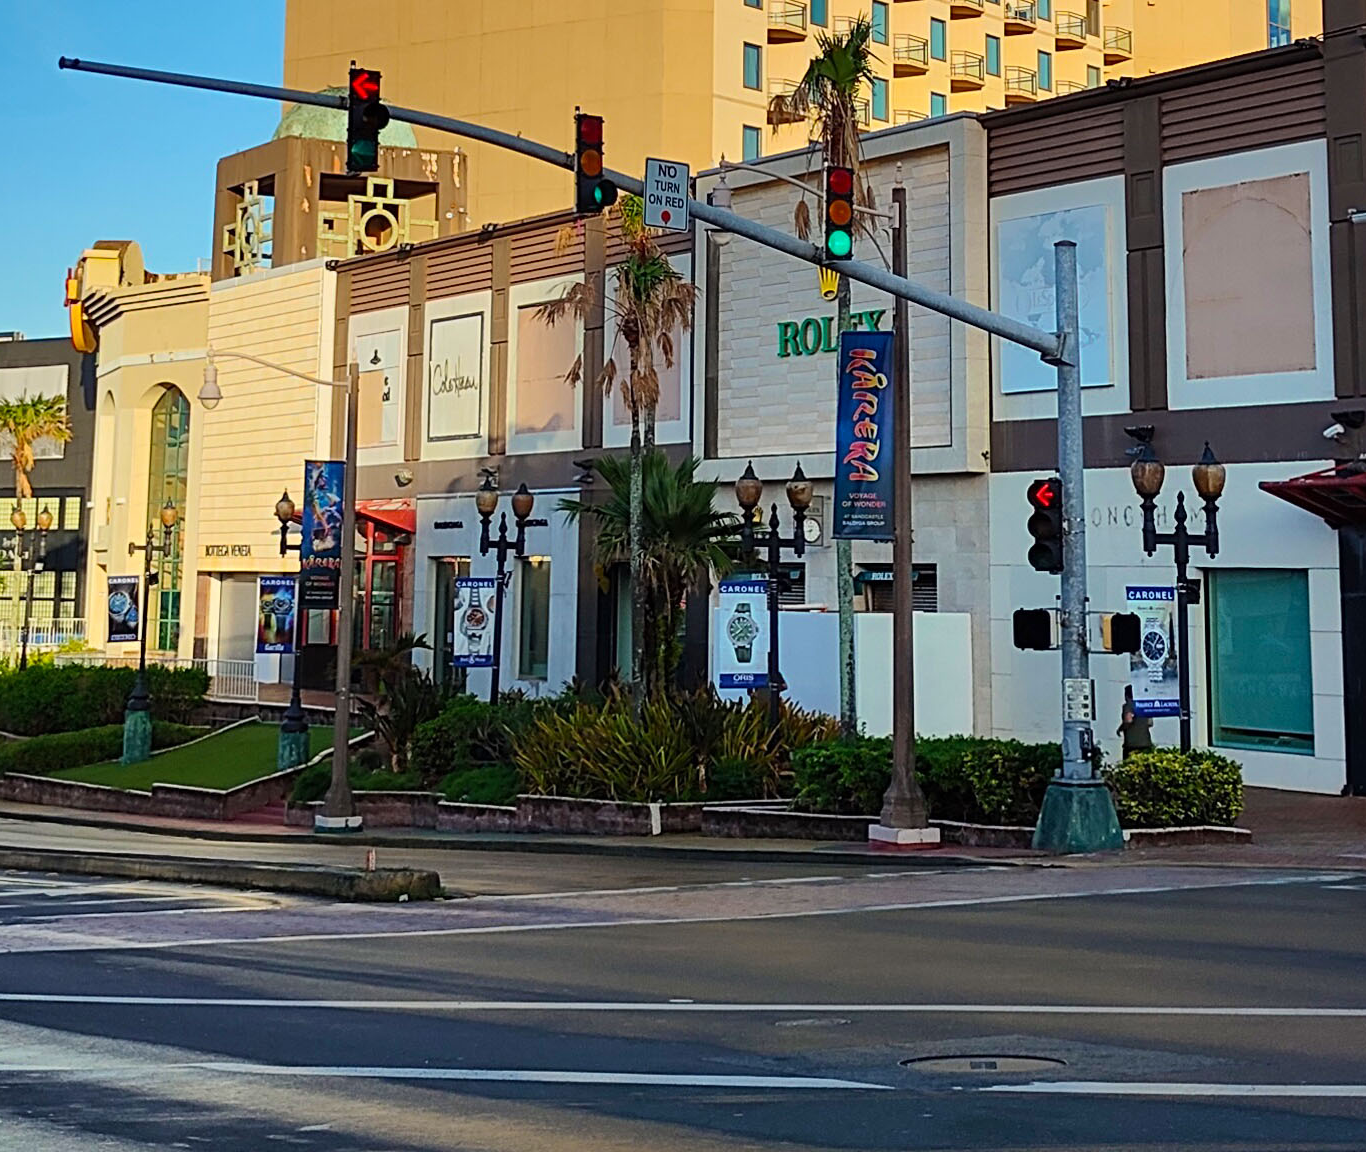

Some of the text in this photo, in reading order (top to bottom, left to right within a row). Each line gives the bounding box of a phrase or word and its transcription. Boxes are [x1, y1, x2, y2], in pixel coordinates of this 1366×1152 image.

[658, 163, 677, 178] NO
[655, 180, 680, 194] TURN
[648, 193, 684, 209] ON RED
[842, 500, 886, 508] OF WONDER
[205, 545, 229, 557] BOTTEGA
[720, 585, 766, 593] CARONEL
[1128, 590, 1173, 600] CARONEL
[733, 674, 754, 682] ORIS
